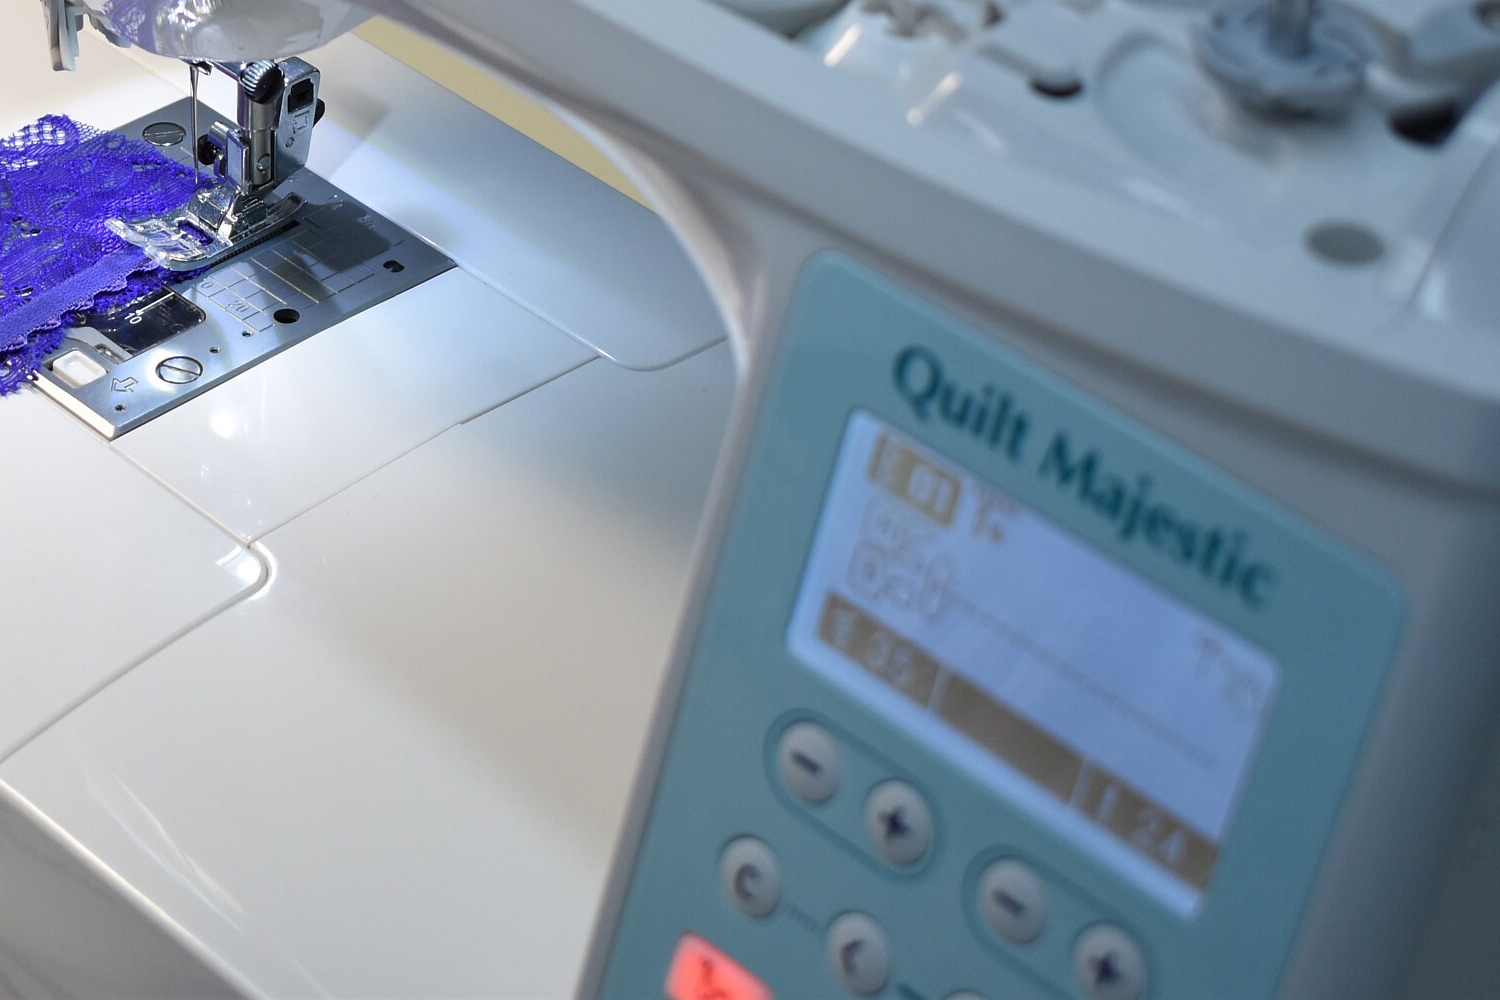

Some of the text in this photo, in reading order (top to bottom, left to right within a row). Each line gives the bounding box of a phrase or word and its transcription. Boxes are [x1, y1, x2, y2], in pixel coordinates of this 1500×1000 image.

[124, 311, 143, 325] 10
[892, 345, 1278, 611] Quilt Majestic
